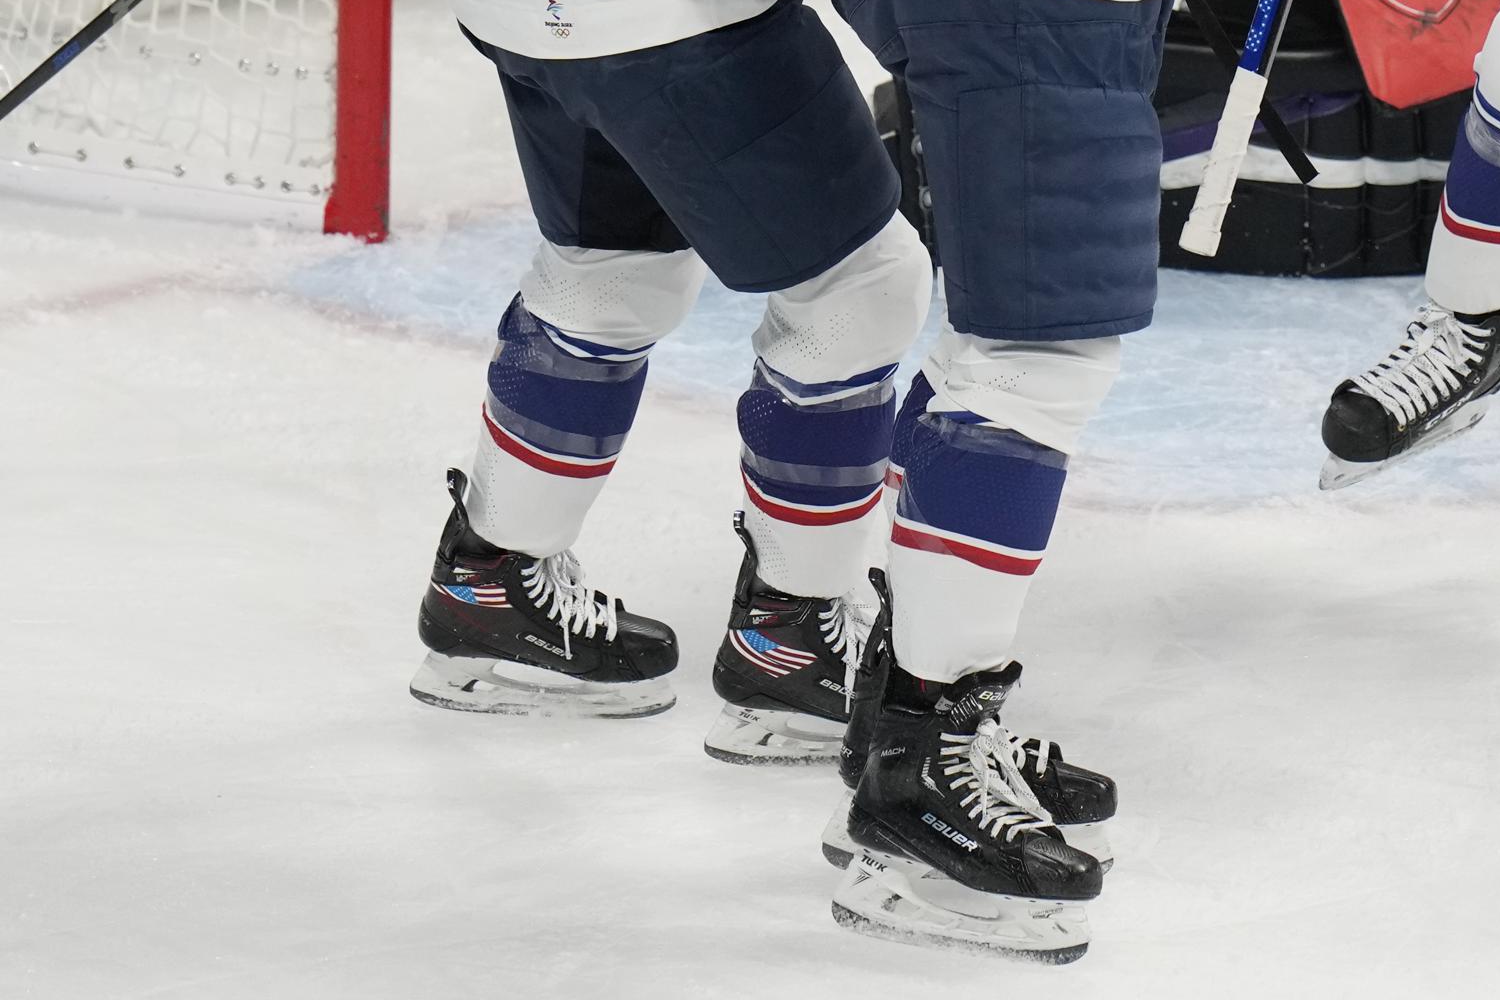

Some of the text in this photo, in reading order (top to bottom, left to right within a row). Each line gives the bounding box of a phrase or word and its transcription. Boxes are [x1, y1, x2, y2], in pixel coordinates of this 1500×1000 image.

[524, 634, 567, 657] BAUE
[880, 746, 907, 758] MACH
[920, 812, 980, 853] BAUER
